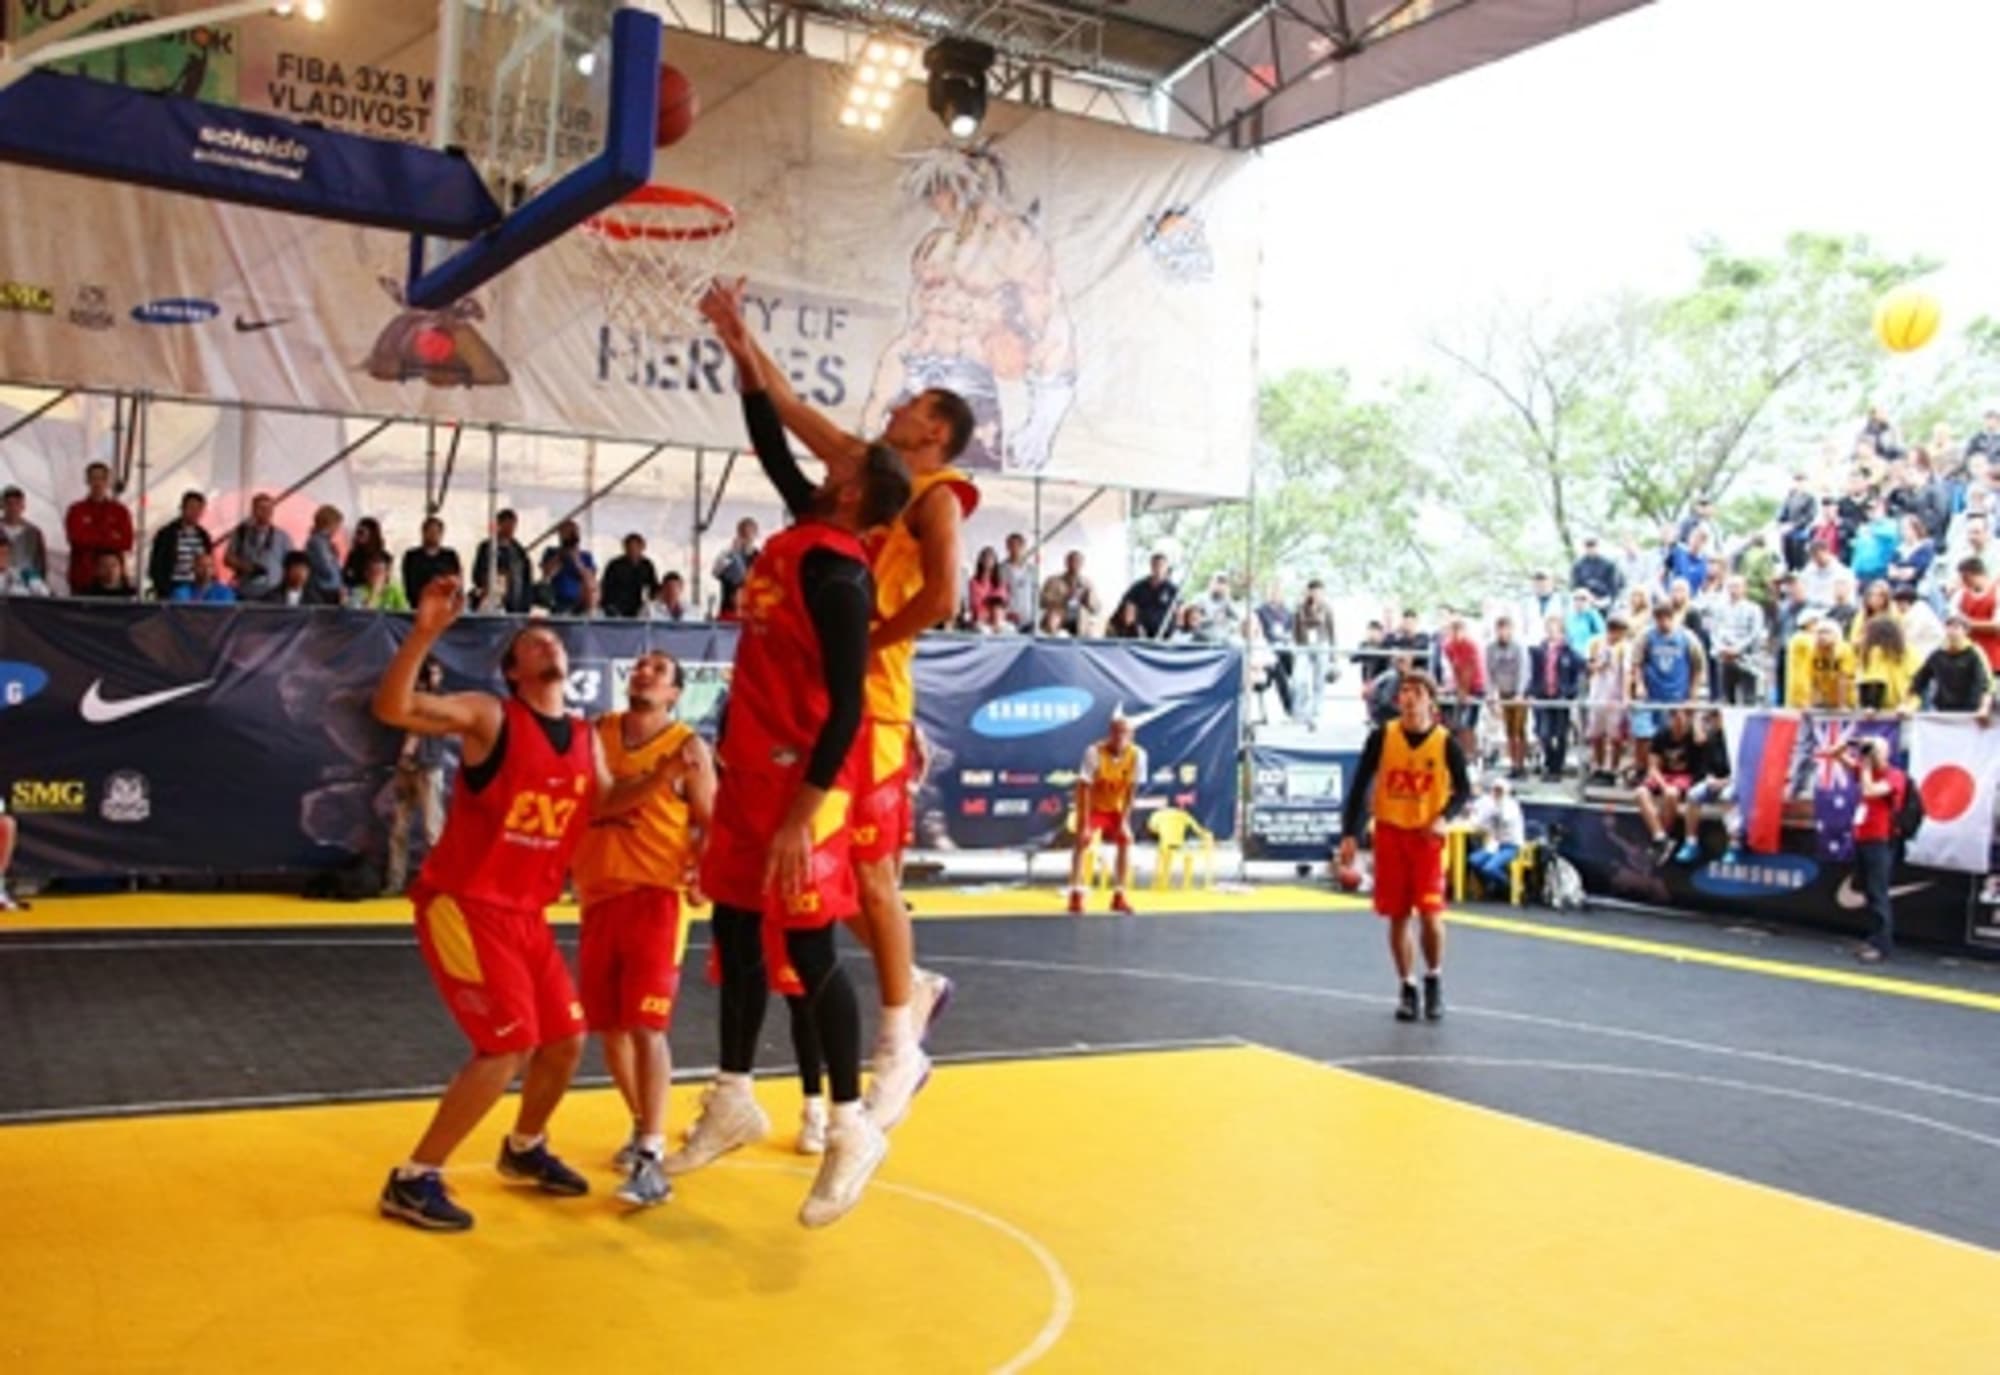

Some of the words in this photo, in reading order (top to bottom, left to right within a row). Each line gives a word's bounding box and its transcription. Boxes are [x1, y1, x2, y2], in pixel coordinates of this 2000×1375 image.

[277, 53, 345, 87] FIBA
[355, 65, 407, 98] 3X3
[417, 76, 519, 116] WRLD
[797, 303, 849, 340] OF
[598, 325, 846, 406] HERES
[11, 781, 85, 805] SMG
[1708, 860, 1806, 889] SAMSUNG
